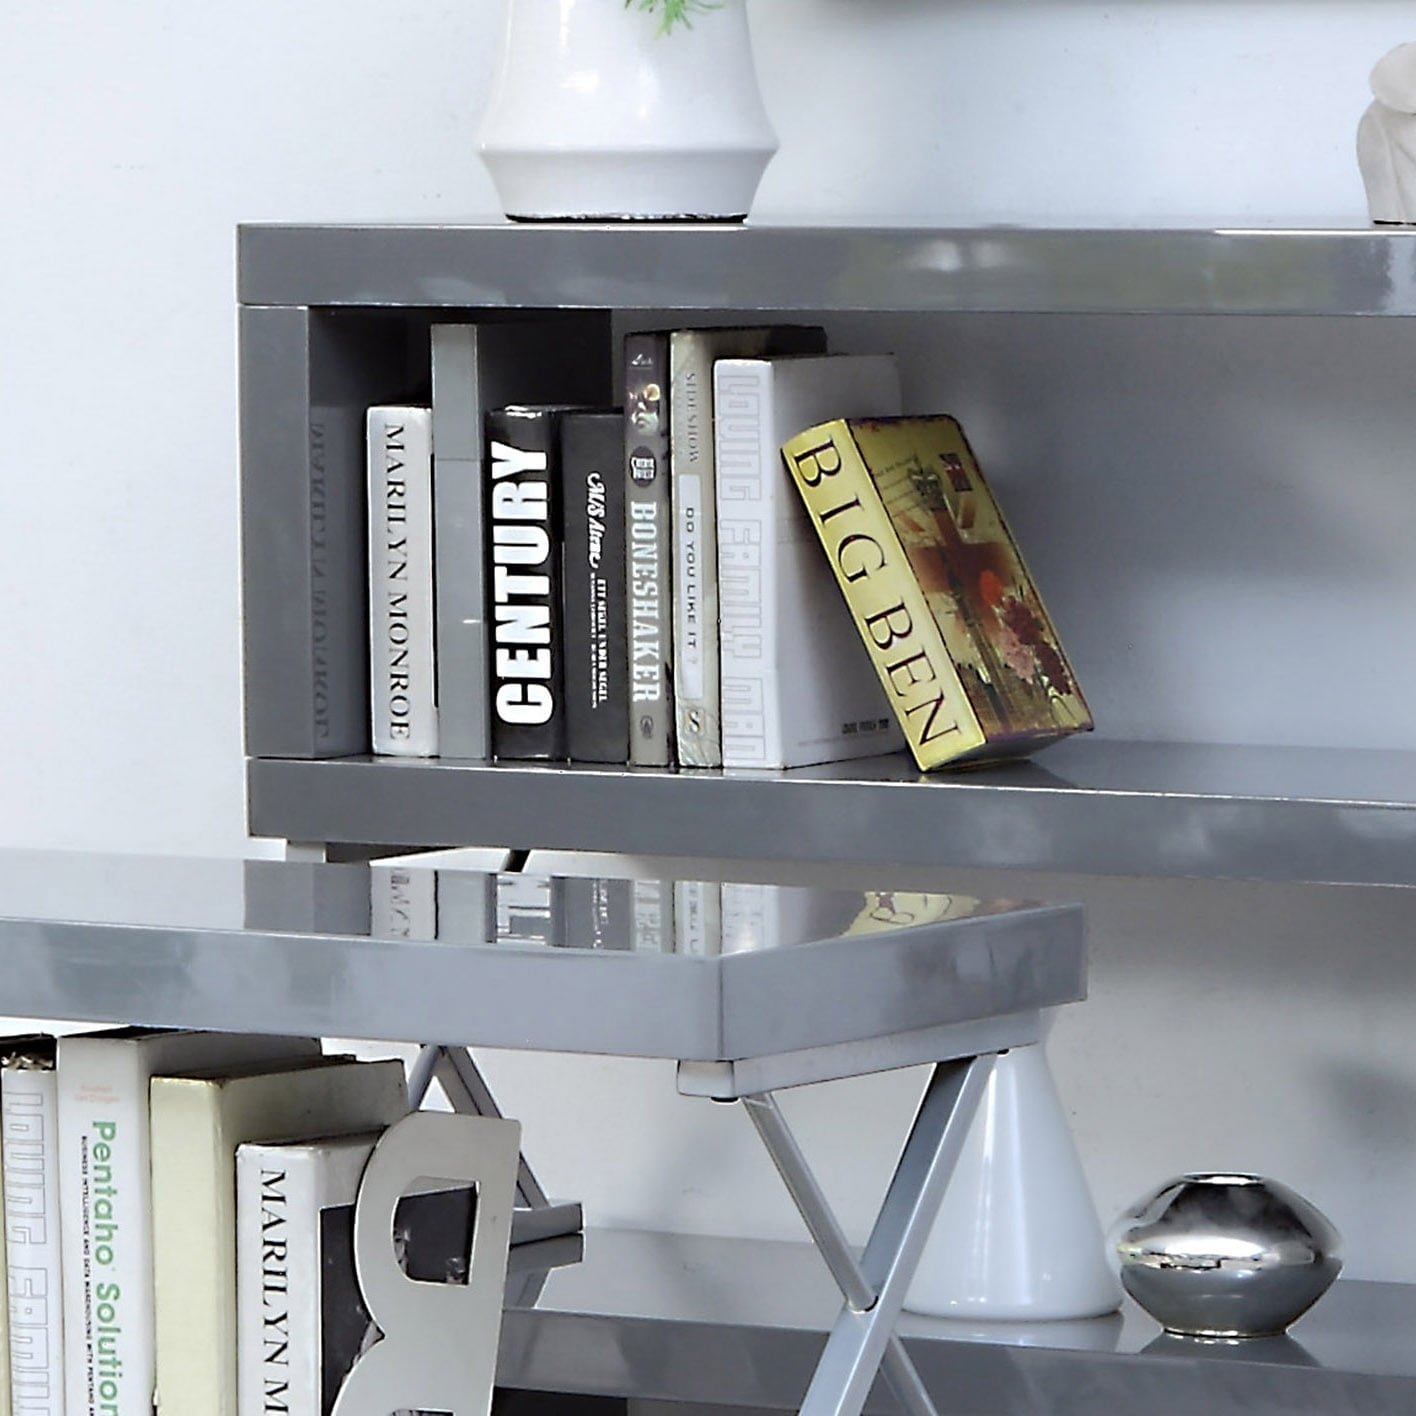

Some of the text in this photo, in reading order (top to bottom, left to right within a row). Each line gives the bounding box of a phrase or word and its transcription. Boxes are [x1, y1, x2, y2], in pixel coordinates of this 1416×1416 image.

[384, 422, 411, 741] MARILYN MONROE
[490, 441, 554, 725] CENTURY
[630, 501, 662, 703] BONESHAKER
[684, 507, 696, 532] DO
[684, 541, 697, 577] YOU
[685, 582, 697, 626] LIKE
[793, 439, 888, 584] BIG
[865, 601, 963, 748] BEN
[686, 630, 697, 649] IT
[92, 1121, 118, 1266] Pentaho
[260, 1168, 287, 1366] MARILYN
